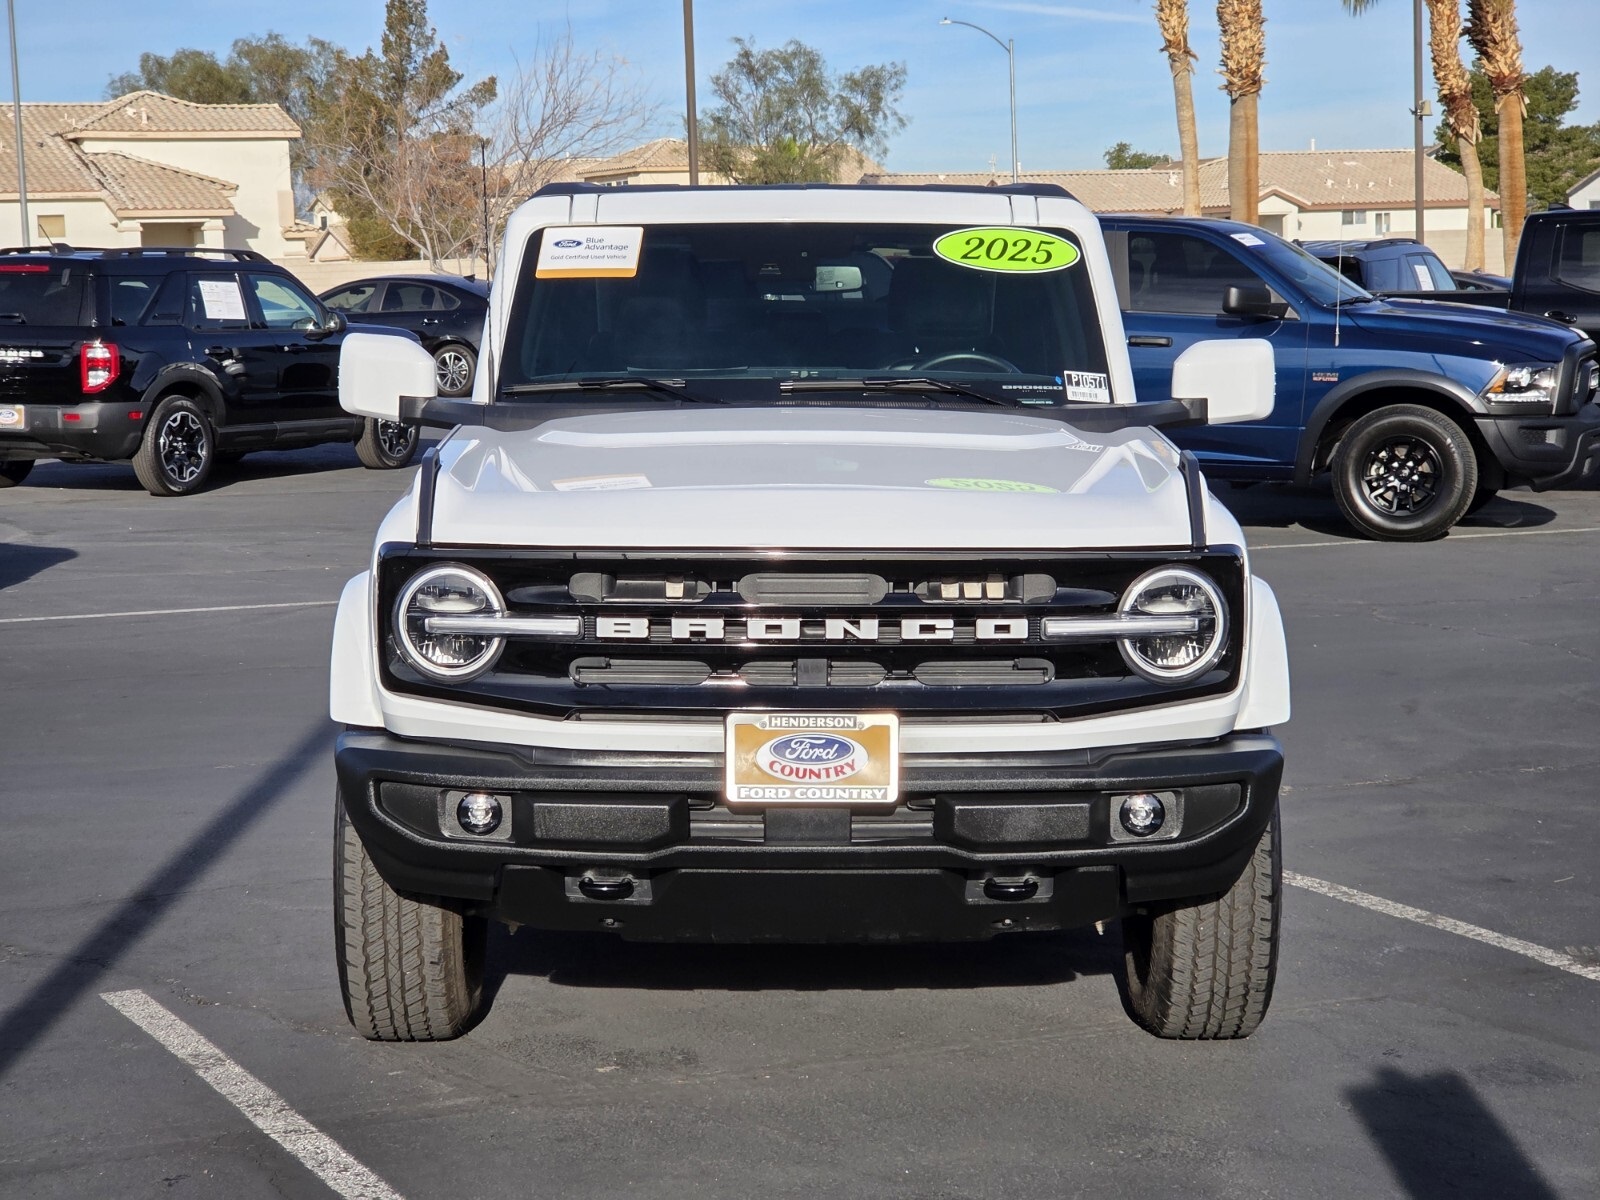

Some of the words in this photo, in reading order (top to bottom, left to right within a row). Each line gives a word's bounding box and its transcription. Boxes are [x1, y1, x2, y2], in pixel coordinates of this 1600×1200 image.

[960, 236, 1056, 265] 2025
[1071, 373, 1108, 390] P10571
[596, 617, 1028, 639] BRONCO
[770, 716, 856, 728] HENDERSON
[785, 738, 838, 760] Ford
[768, 759, 857, 779] COUNTRY
[739, 787, 792, 800] FORD
[794, 787, 886, 800] COUNTRY
